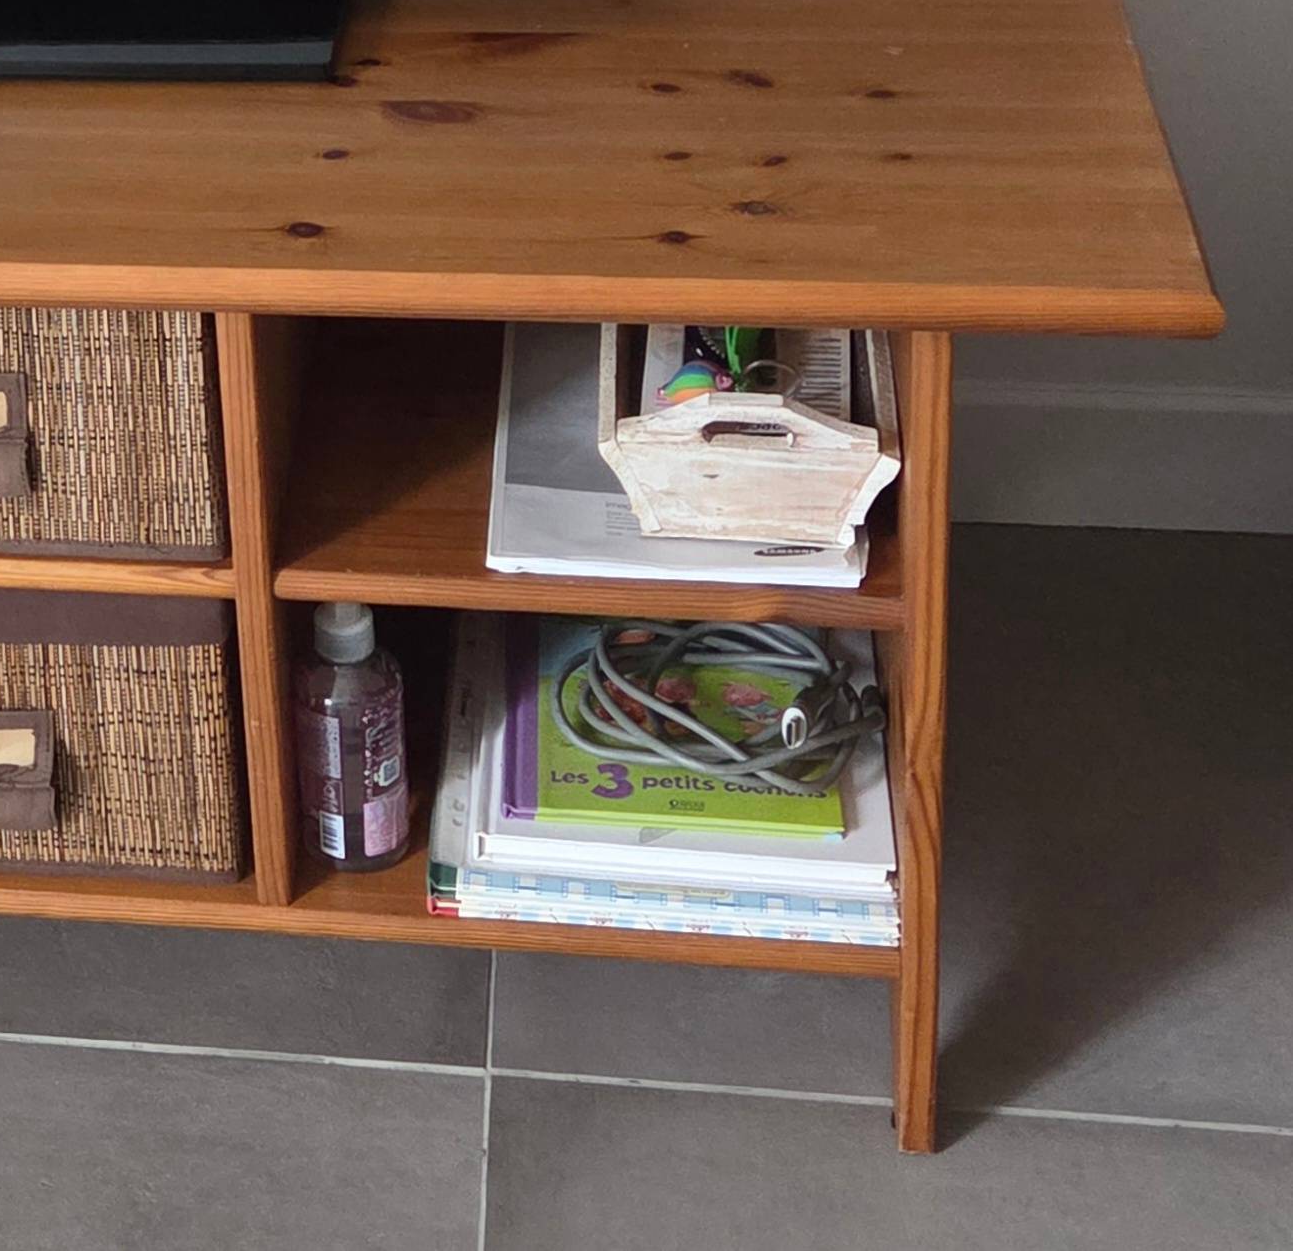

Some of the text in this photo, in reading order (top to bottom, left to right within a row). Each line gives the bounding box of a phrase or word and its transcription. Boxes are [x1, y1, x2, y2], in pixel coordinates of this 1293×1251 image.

[551, 769, 590, 785] Les
[591, 763, 635, 799] 3
[642, 775, 716, 793] petits
